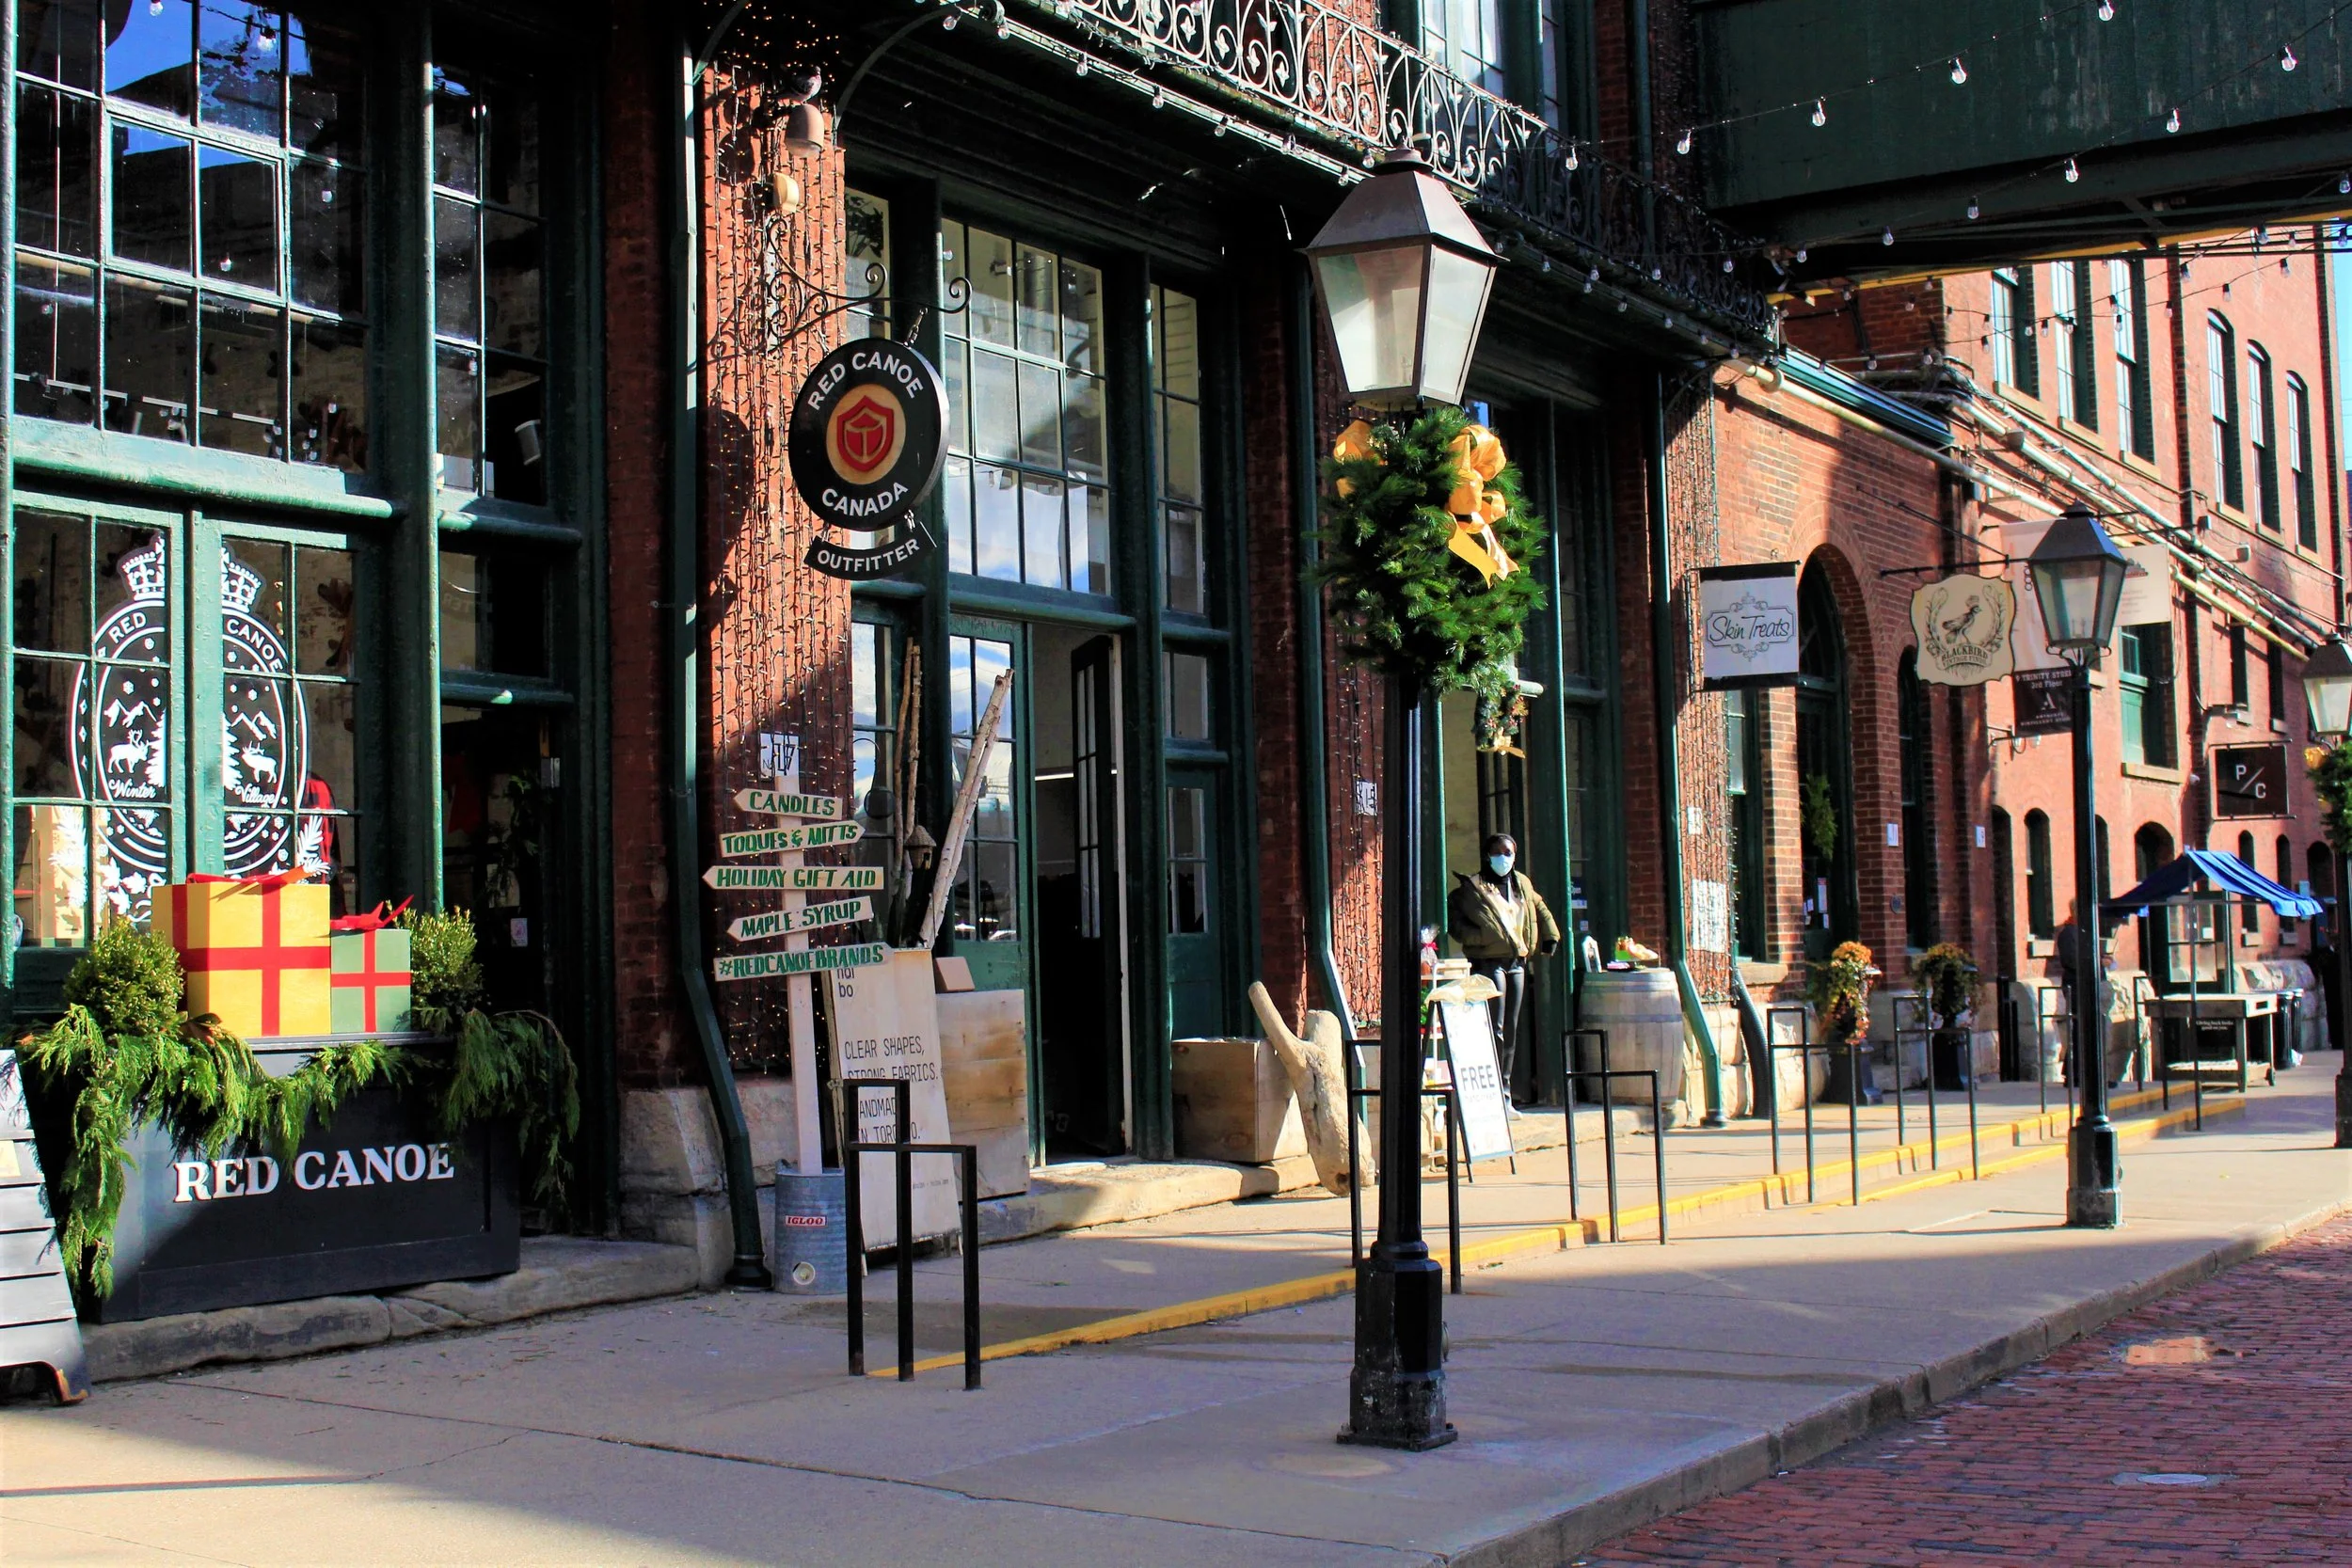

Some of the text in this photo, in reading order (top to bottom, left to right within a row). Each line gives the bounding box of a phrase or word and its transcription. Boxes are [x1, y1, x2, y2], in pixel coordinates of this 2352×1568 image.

[808, 352, 924, 411] RED CANOE
[821, 482, 909, 517] CANADA
[818, 539, 920, 573] OUTFITTER
[1709, 614, 1790, 641] Skin Treats
[108, 611, 283, 673] RED CANOE
[2022, 672, 2050, 681] TRINITY
[108, 778, 156, 799] Winter
[235, 784, 277, 808] Village
[749, 791, 835, 816] CANDLES
[723, 824, 858, 854] TOQUES & MITTS
[717, 868, 876, 888] HOLIDAY GIFT AID
[740, 900, 862, 938] MAPLE SYRUP
[719, 943, 884, 978] #REDCANOEBRANDS
[838, 982, 854, 997] bo
[844, 1036, 925, 1060] CLEAR SHAPES,
[892, 1062, 939, 1084] FABRICS.
[1460, 1064, 1496, 1092] FREE
[173, 1142, 454, 1203] RED CANOE
[787, 1216, 824, 1225] IGLOO
